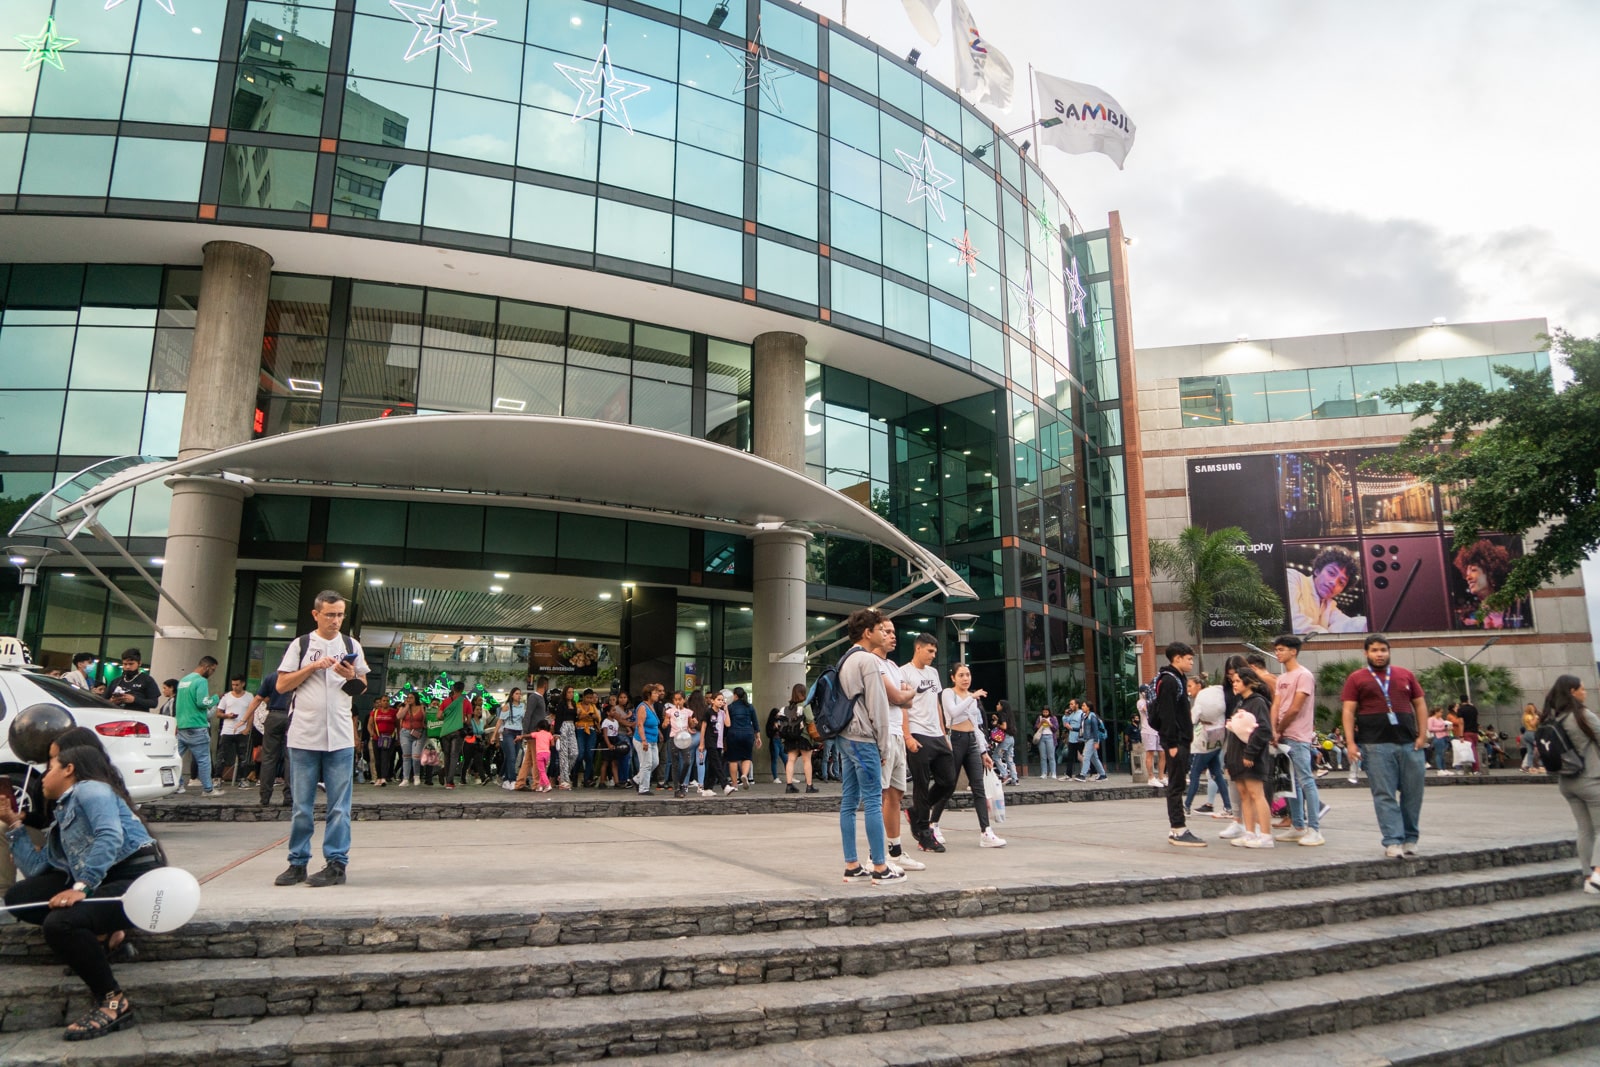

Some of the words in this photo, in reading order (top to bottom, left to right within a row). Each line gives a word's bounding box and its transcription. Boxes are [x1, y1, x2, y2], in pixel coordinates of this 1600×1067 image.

[1054, 99, 1129, 134] SAMBIL
[1194, 462, 1242, 473] SAMSUNG
[150, 889, 164, 927] swatch
